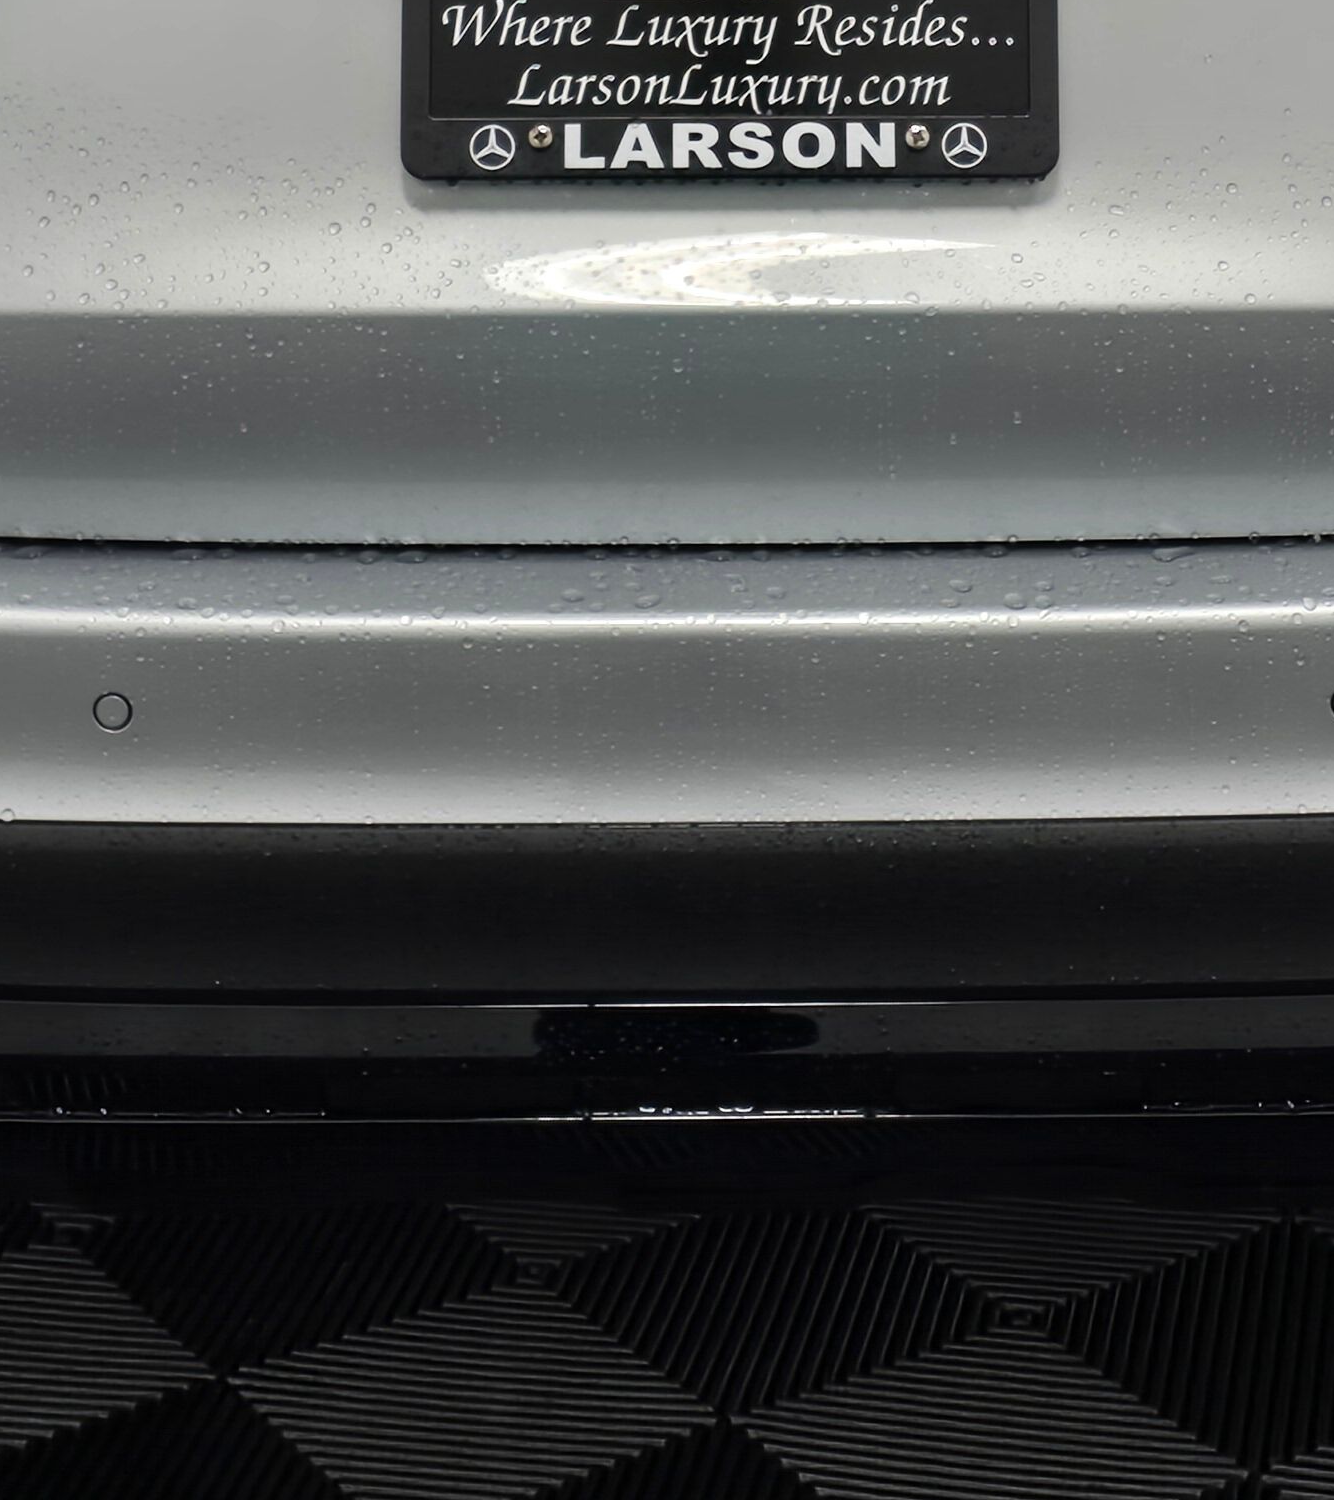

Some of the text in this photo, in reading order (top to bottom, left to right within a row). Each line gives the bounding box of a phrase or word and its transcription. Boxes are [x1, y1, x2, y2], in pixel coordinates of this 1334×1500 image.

[605, 4, 778, 65] Luxury
[506, 63, 952, 115] LarsonLuxury.com
[563, 121, 897, 169] LARSON
